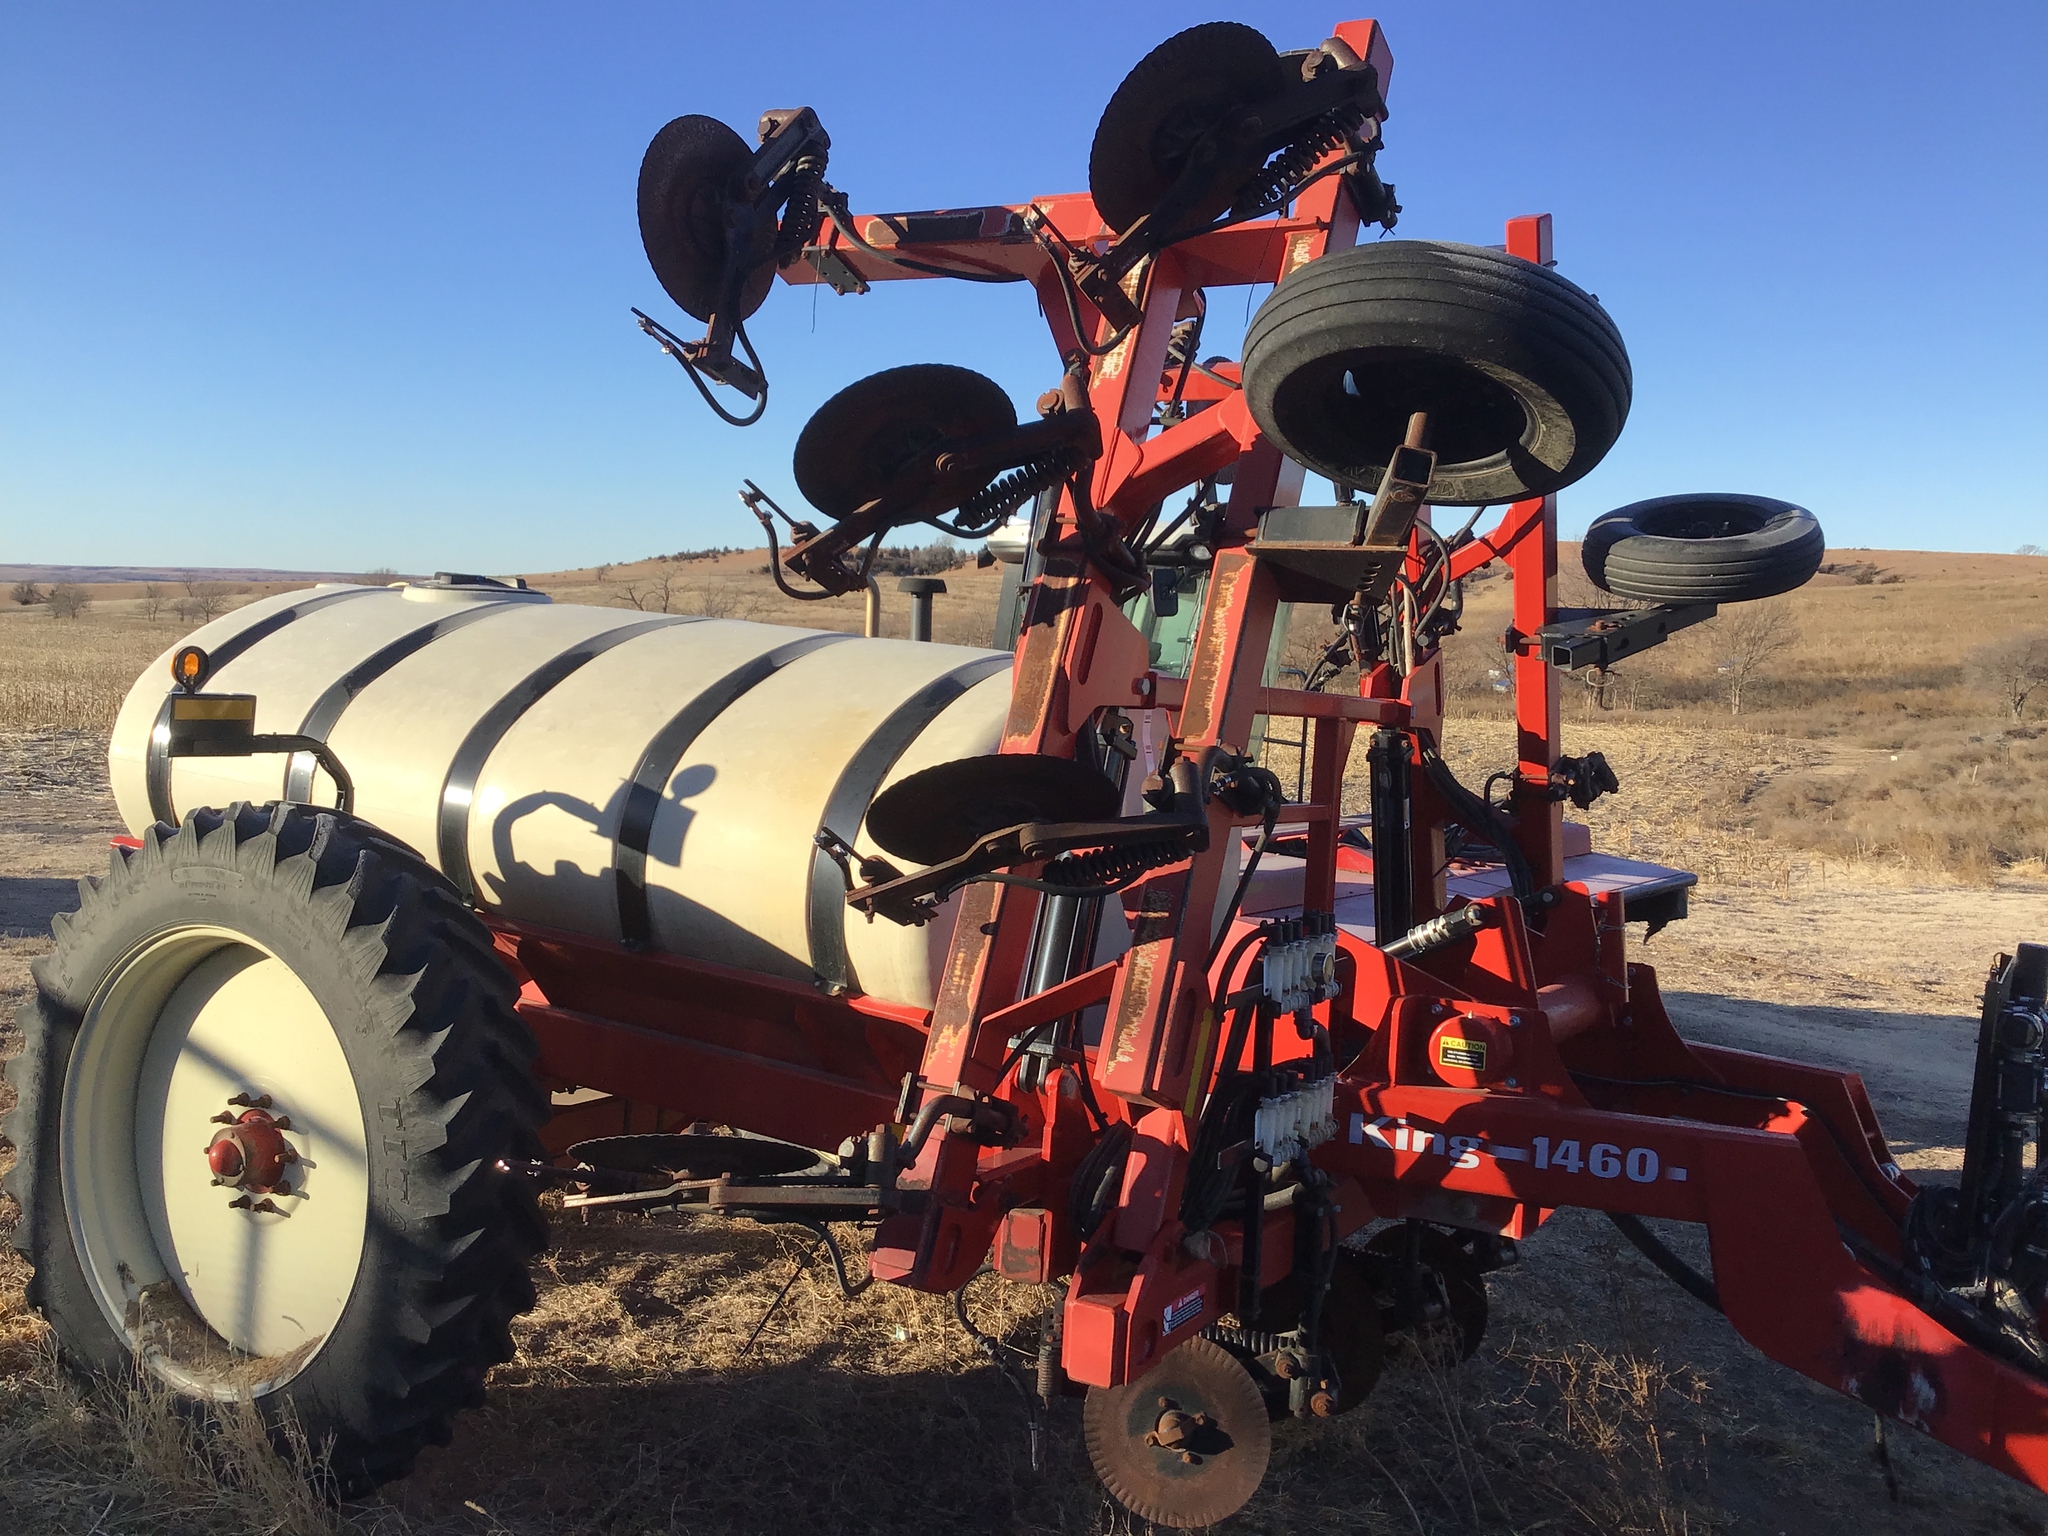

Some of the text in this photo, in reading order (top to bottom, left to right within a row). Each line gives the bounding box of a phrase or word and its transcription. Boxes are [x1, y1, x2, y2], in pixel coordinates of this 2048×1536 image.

[1450, 1040, 1486, 1051] CAUTION
[1348, 1113, 1660, 1183] King 1460
